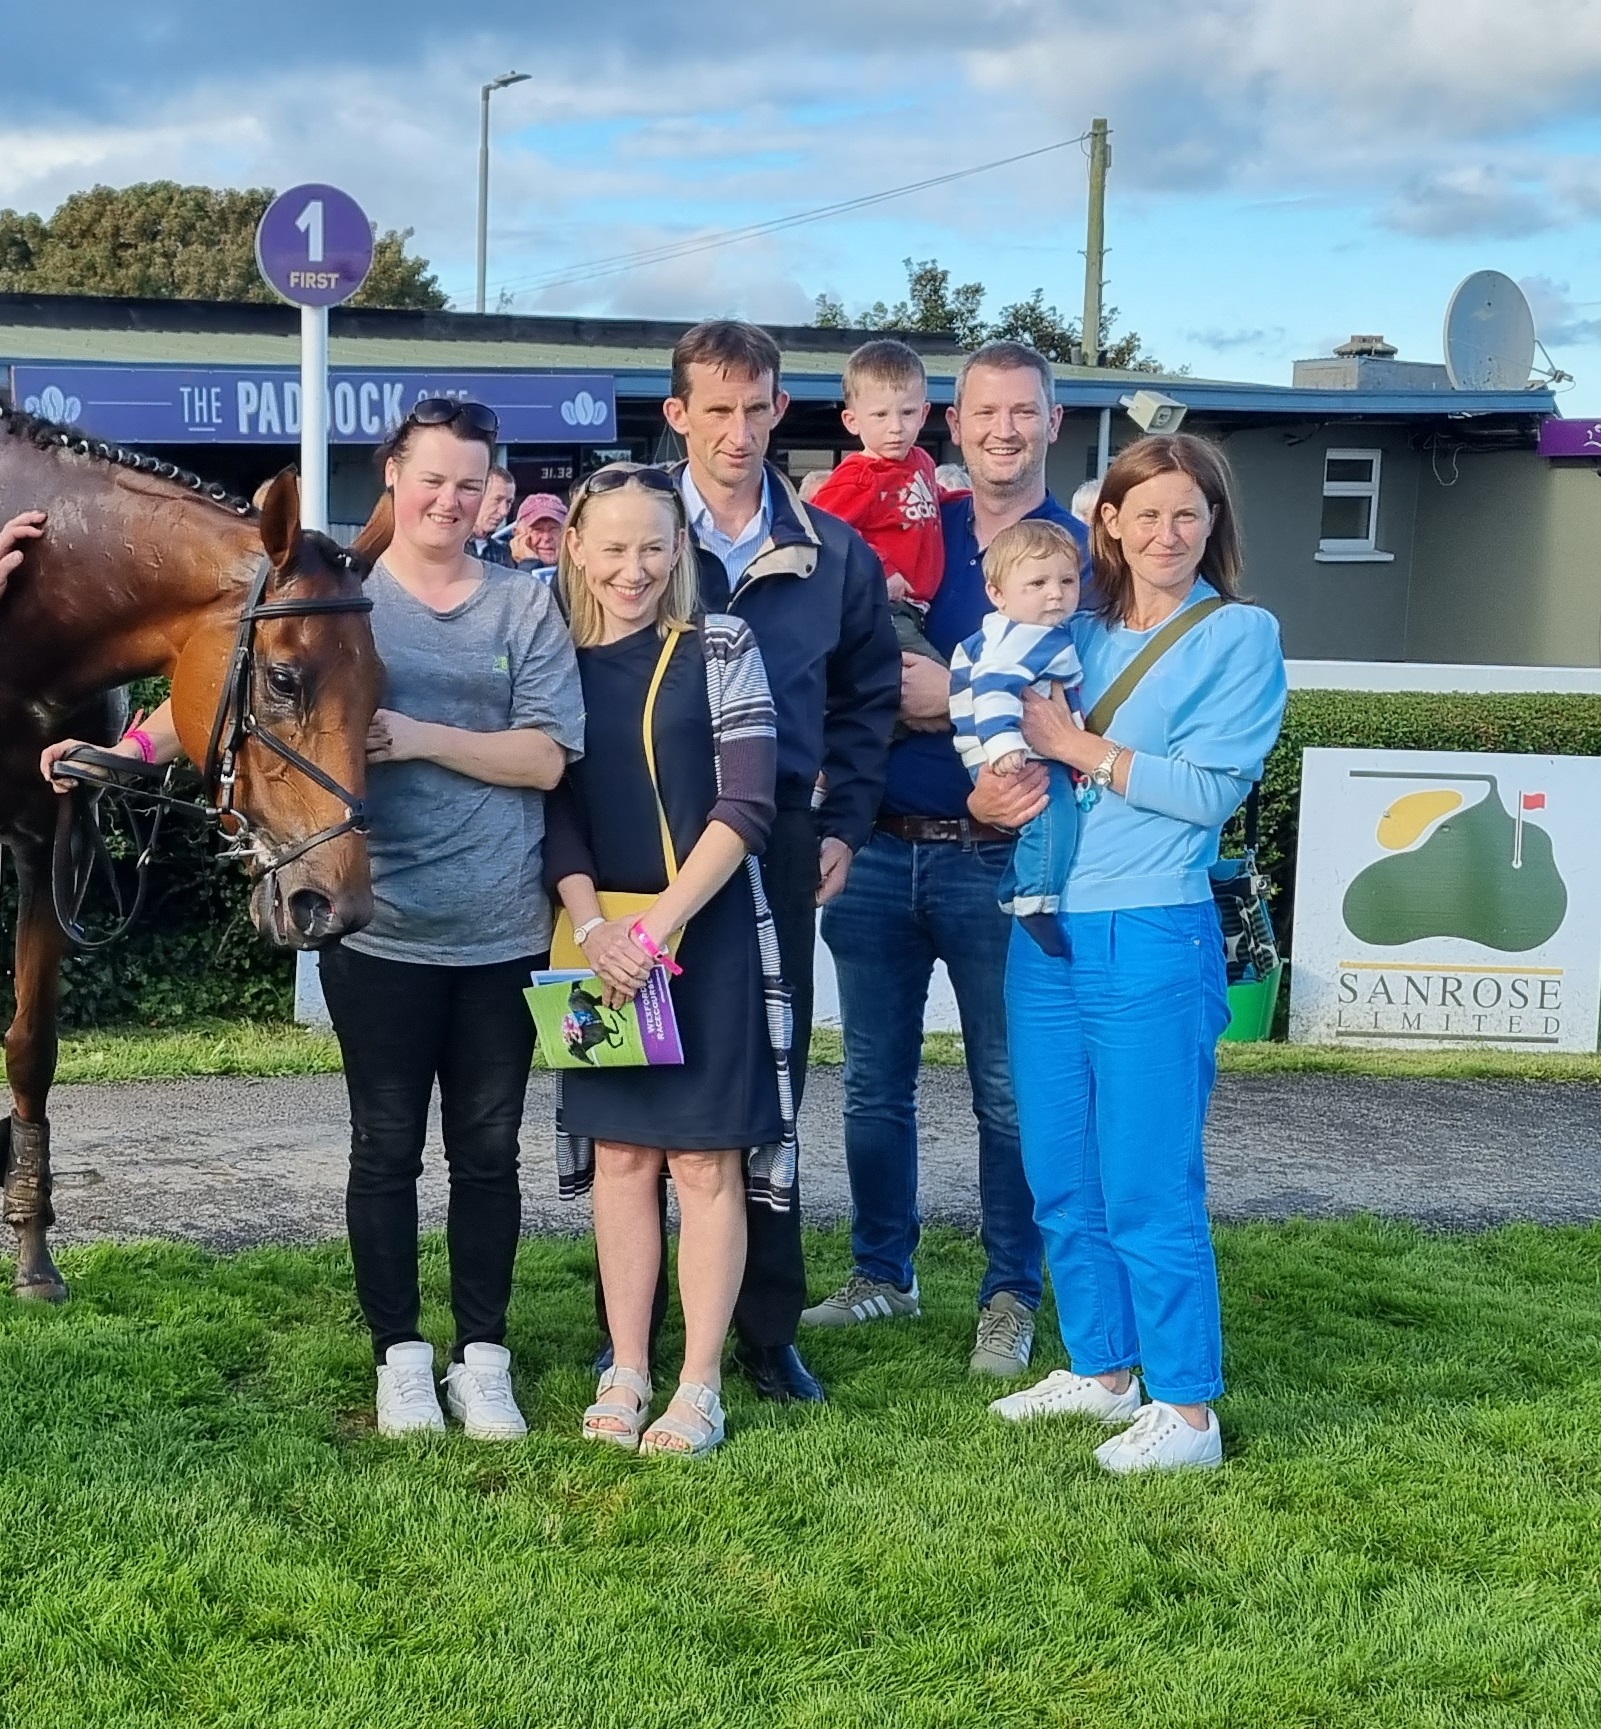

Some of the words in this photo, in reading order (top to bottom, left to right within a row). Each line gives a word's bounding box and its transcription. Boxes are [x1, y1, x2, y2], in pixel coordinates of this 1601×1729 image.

[294, 201, 324, 262] 1
[289, 271, 340, 289] FIRST
[179, 386, 223, 424] THE
[237, 380, 404, 435] PADOCK
[1337, 972, 1563, 1011] SANROSE
[1337, 1010, 1561, 1035] LIMITED
